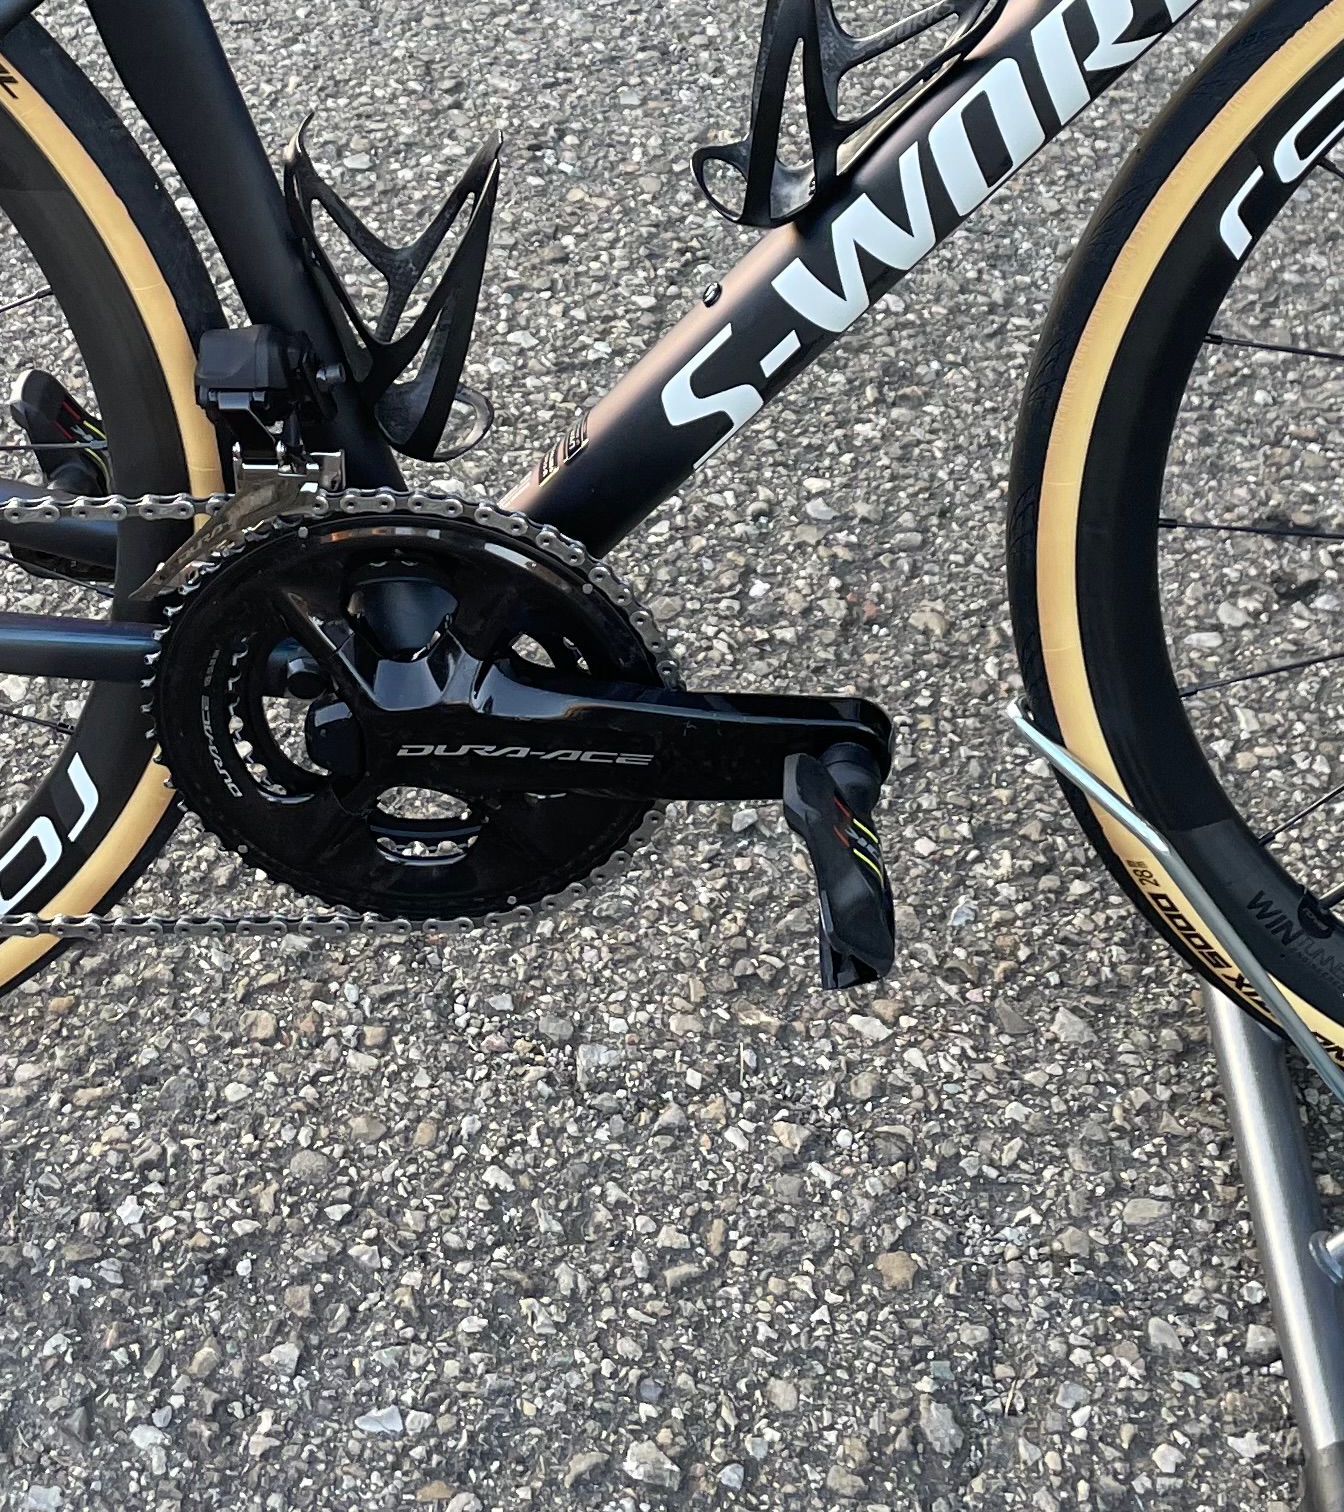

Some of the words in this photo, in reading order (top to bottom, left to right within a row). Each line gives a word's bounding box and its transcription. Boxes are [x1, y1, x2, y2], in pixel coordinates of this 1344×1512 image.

[200, 694, 244, 799] DURA-ACE
[396, 744, 655, 767] DURA-ACE
[1132, 867, 1160, 888] 28
[1148, 892, 1232, 970] 5000
[1245, 888, 1306, 947] WIN
